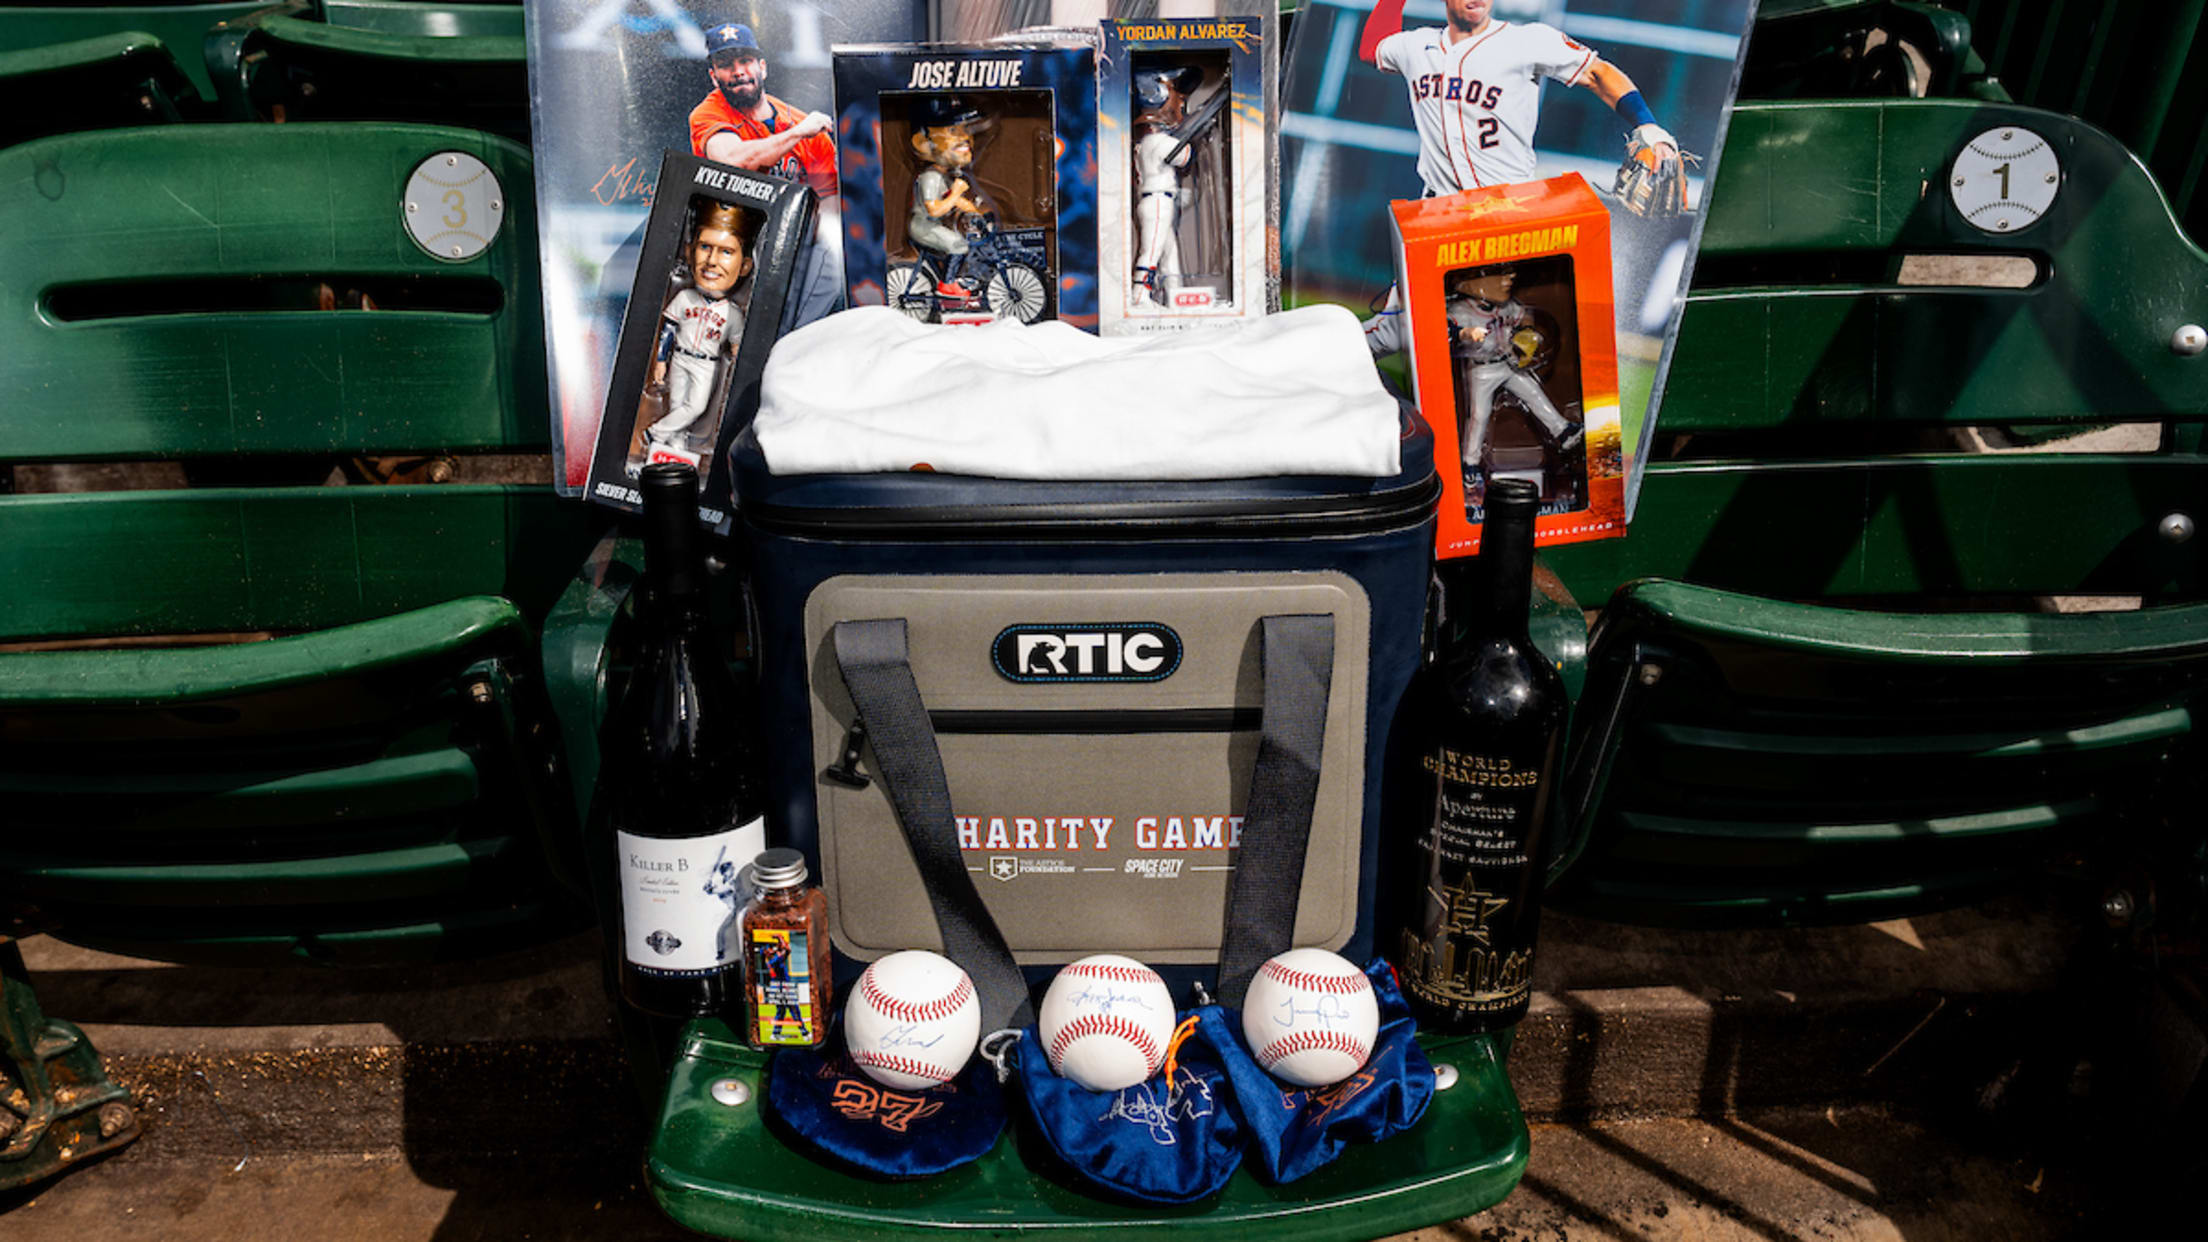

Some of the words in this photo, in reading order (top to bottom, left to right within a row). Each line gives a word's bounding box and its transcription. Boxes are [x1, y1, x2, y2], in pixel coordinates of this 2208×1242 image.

[1116, 24, 1177, 41] YORDAN
[1179, 23, 1247, 40] ALVAREZ
[907, 61, 955, 89] JOSE
[955, 60, 1023, 88] ALTUVE
[1477, 117, 1500, 150] 2
[694, 165, 729, 190] KYLE
[725, 172, 775, 202] TUCKER
[1992, 162, 2010, 200] 1
[441, 189, 468, 229] 3
[1435, 237, 1482, 267] ALEX
[1484, 224, 1579, 260] BREGMAN
[594, 482, 629, 501] SILVER
[1017, 632, 1165, 675] RTIC
[1423, 754, 1538, 788] CHAMPIONS
[1445, 749, 1512, 772] WORLD
[954, 814, 1115, 851] HARITY
[677, 857, 690, 873] B
[1124, 858, 1160, 873] SPACE
[1160, 858, 1185, 873] CITY
[830, 1079, 926, 1133] 27
